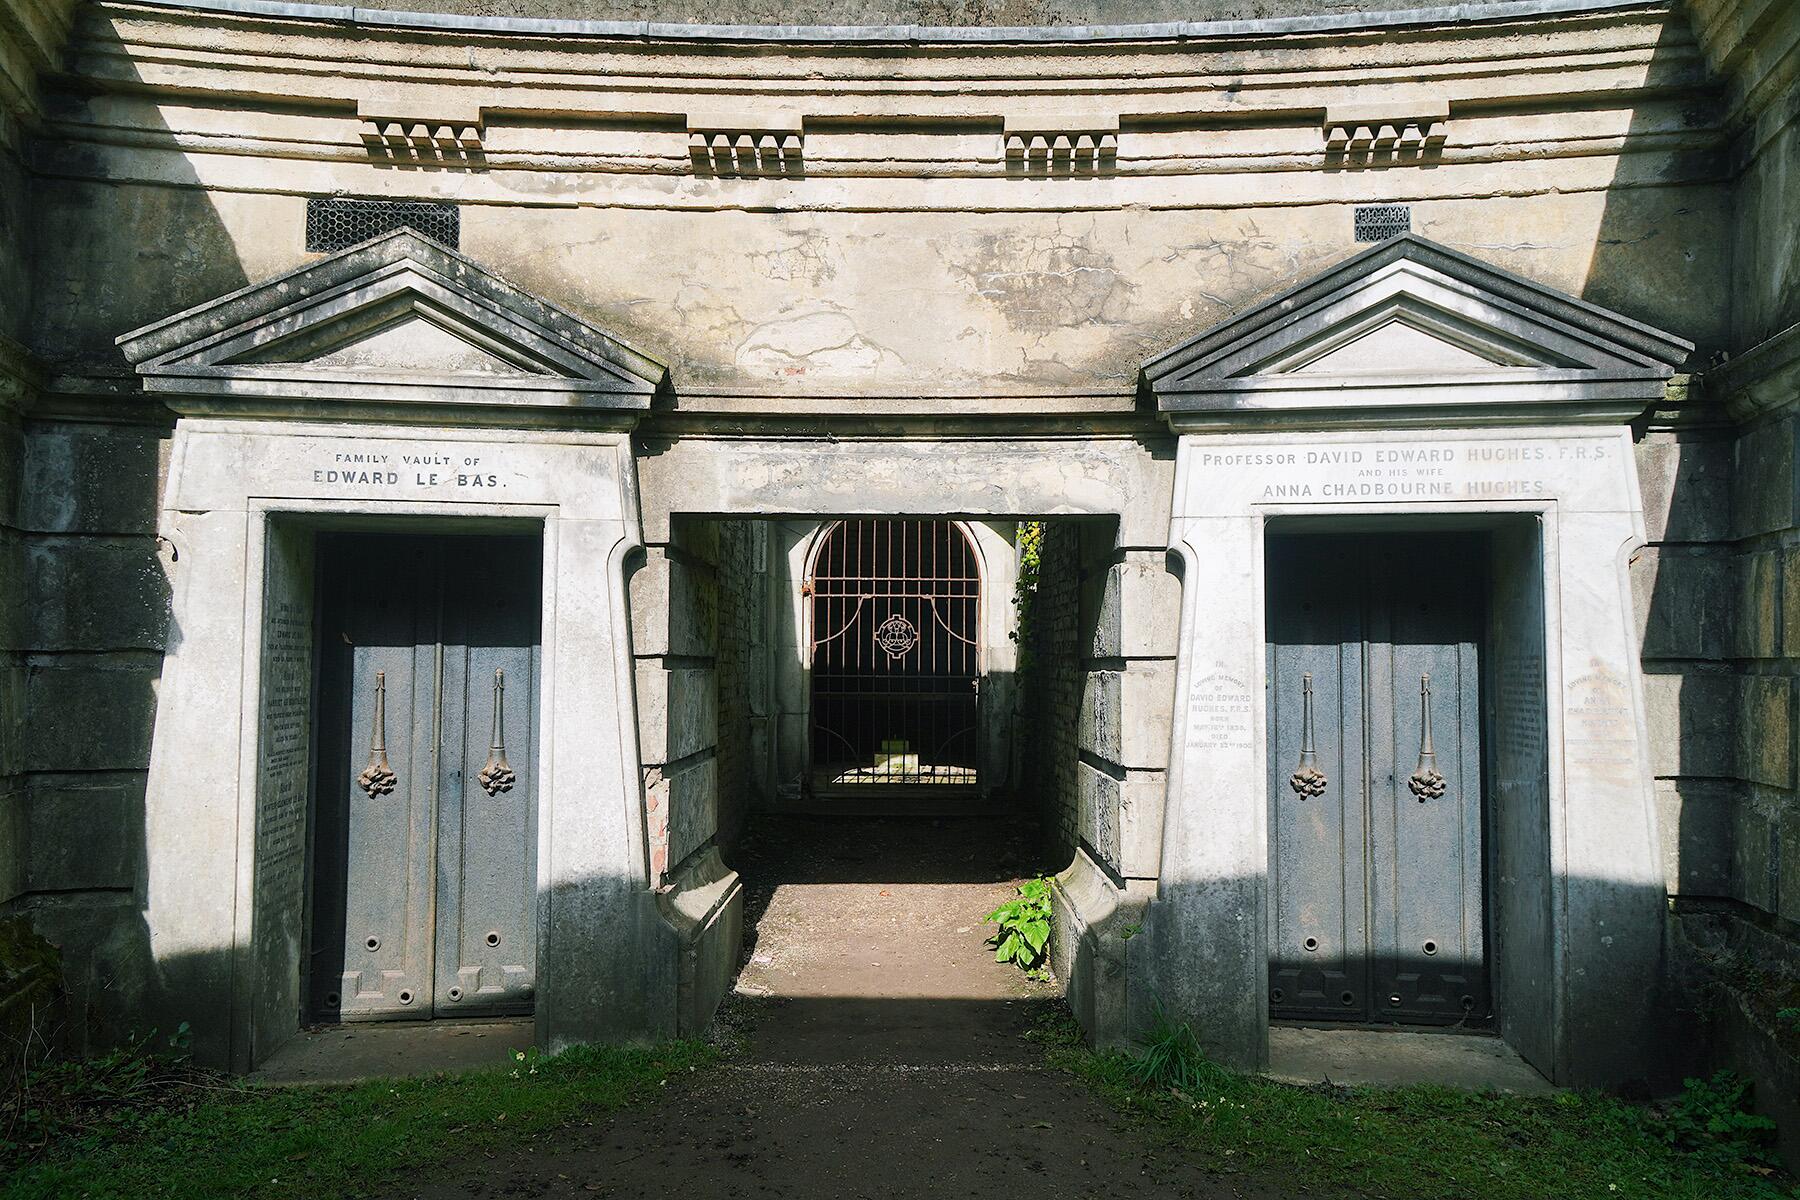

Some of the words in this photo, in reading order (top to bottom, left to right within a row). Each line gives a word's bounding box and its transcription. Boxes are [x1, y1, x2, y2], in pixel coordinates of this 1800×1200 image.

[335, 454, 389, 463] FAMILY
[403, 455, 450, 465] VAULT
[464, 457, 480, 466] OF
[1203, 453, 1296, 466] PROFESSOR
[1307, 450, 1363, 464] DAVID
[1375, 449, 1455, 463] EDWARD
[1559, 446, 1611, 460] F.R.S.
[313, 470, 399, 485] EDWARD
[416, 473, 438, 486] LE
[457, 474, 507, 488] BAS.
[1358, 468, 1382, 477] AND
[1389, 468, 1408, 477] HIS
[1416, 468, 1444, 476] WIFE
[1263, 484, 1313, 497] ANNA
[1322, 482, 1453, 496] CHADBOURNE
[1194, 674, 1216, 688] LOVING
[1218, 674, 1245, 689] MEMORY
[1190, 694, 1214, 702] DAVID
[1216, 694, 1251, 702] EDWARD
